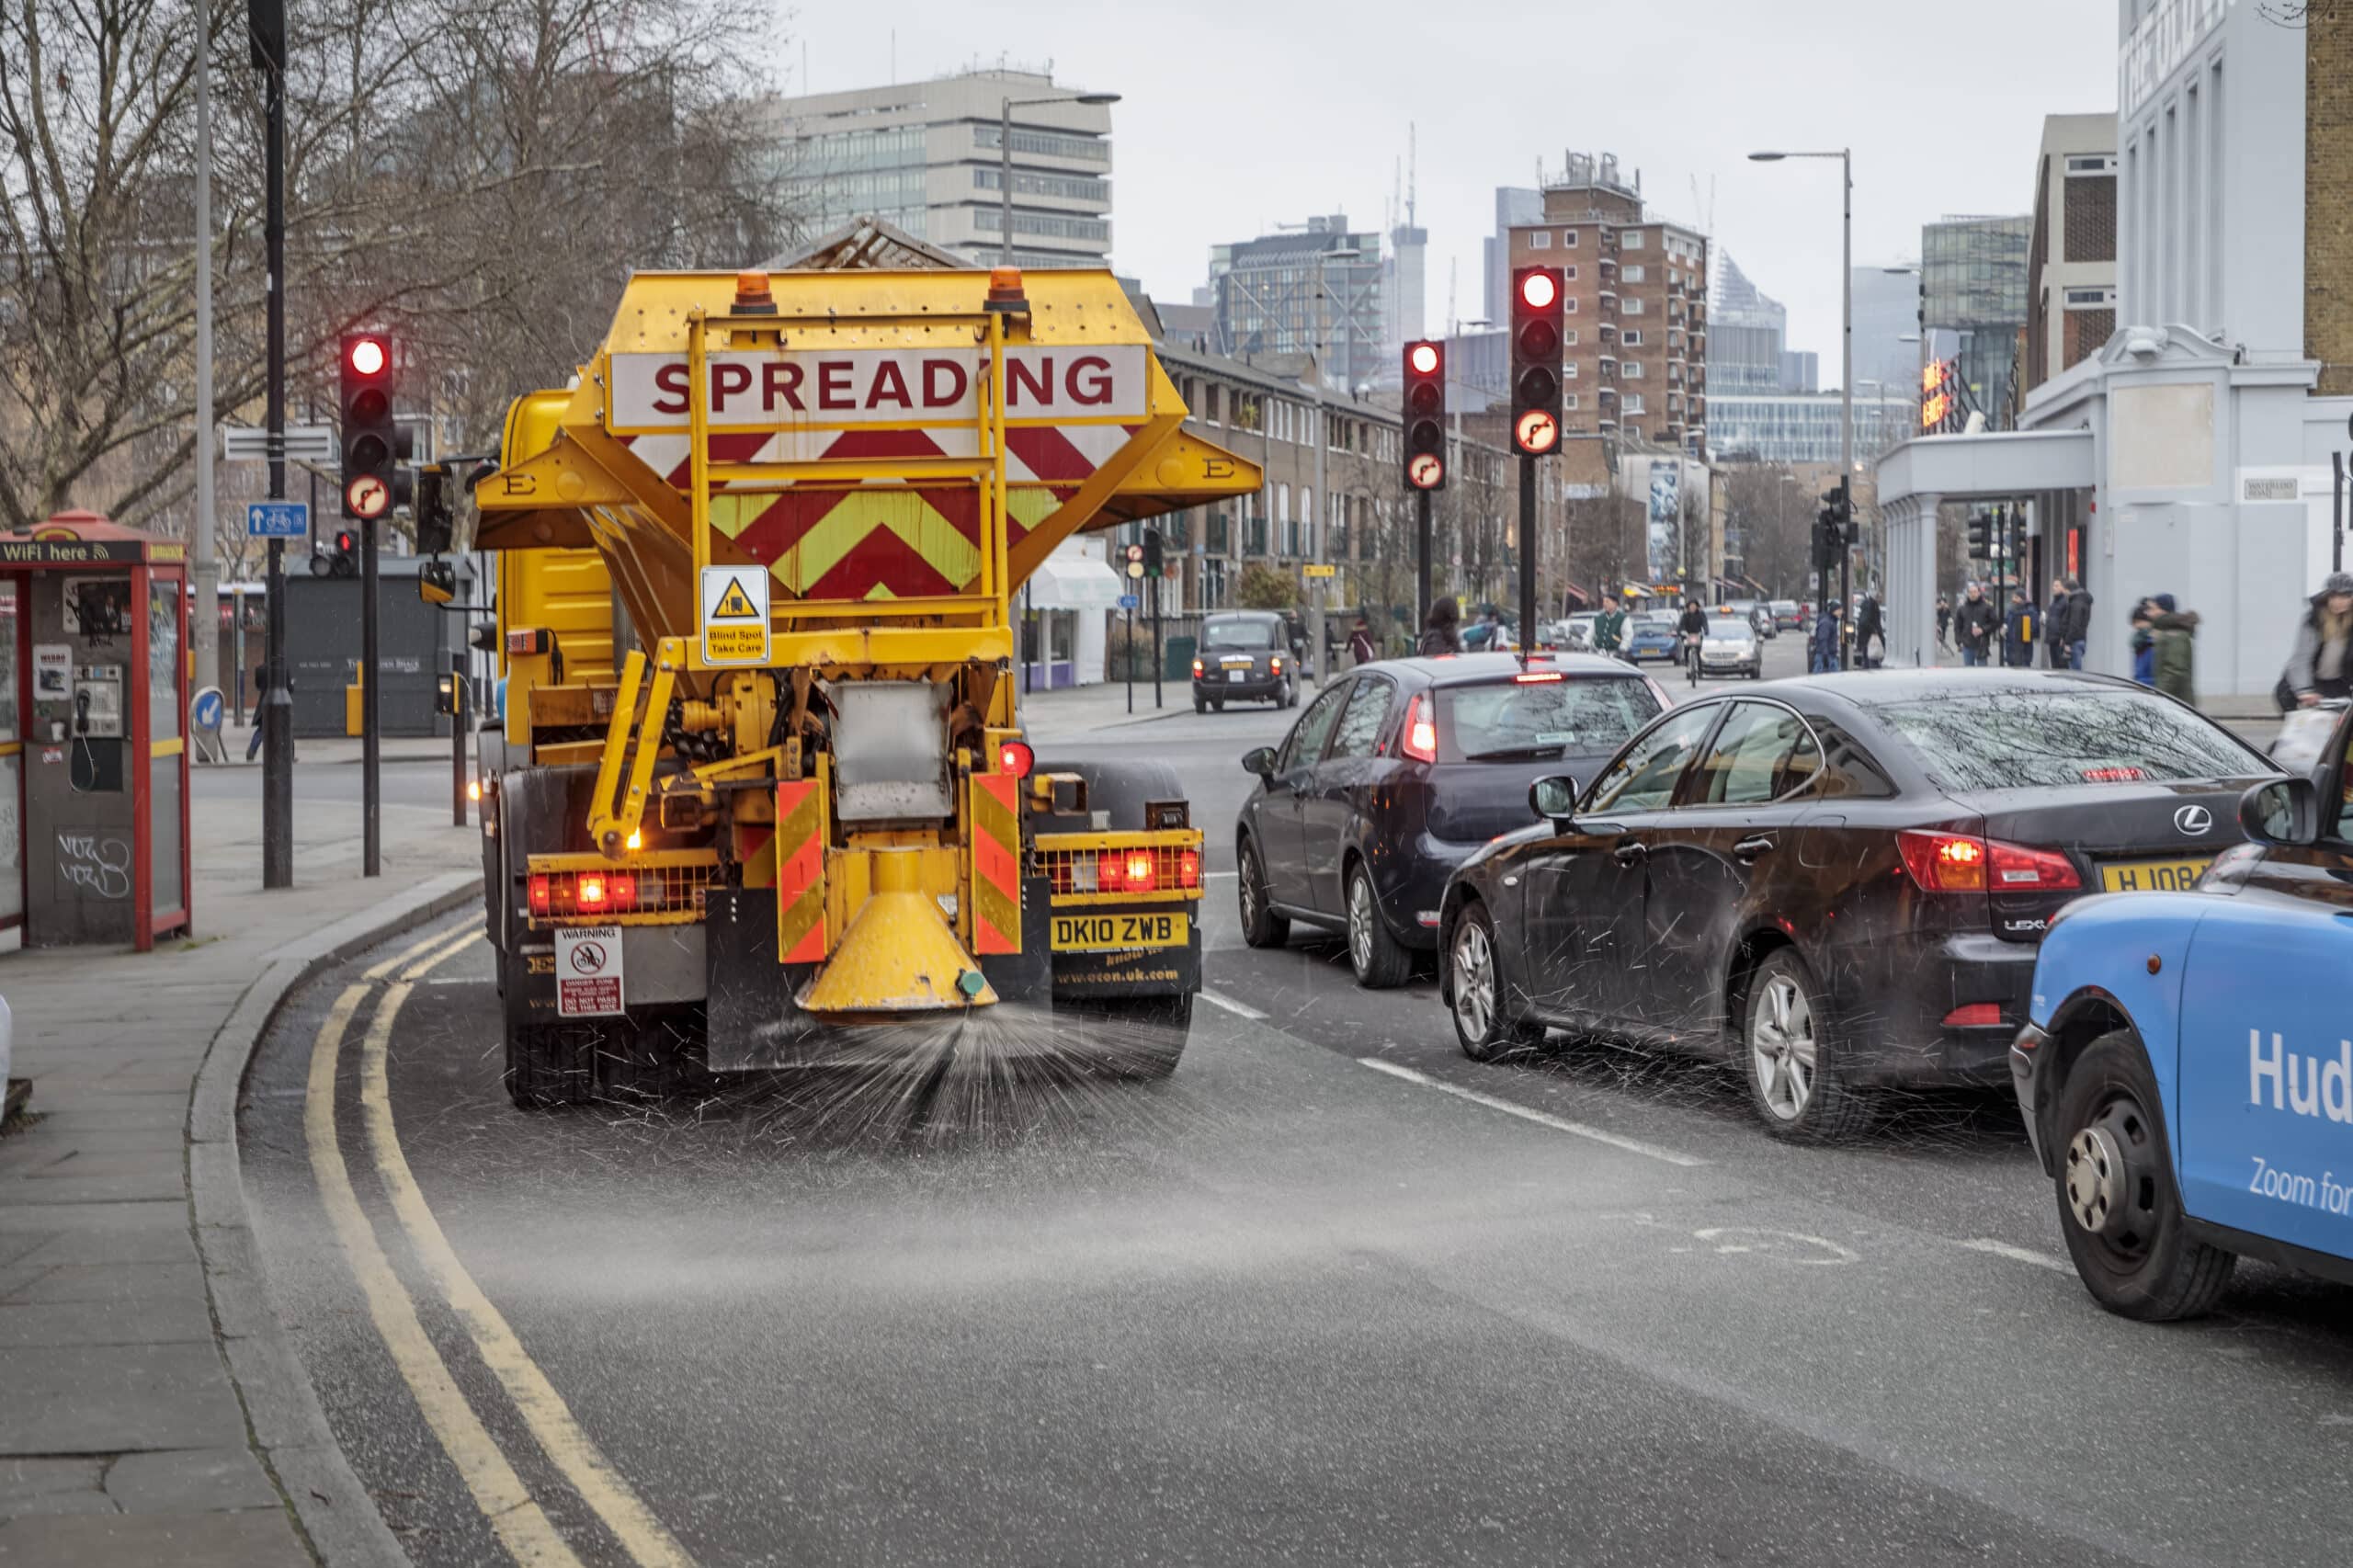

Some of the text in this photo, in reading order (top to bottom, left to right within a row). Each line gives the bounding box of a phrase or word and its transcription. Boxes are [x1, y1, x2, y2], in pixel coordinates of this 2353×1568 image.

[50, 543, 87, 561] here
[710, 629, 762, 641] Blind Spot
[712, 643, 762, 653] Take Care
[562, 927, 616, 939] WARNING
[1057, 916, 1172, 944] DK10 ZWB
[1058, 968, 1178, 984] ww.econ.uk.com
[2250, 1028, 2353, 1124] Hud
[2249, 1156, 2353, 1215] Zoom for
